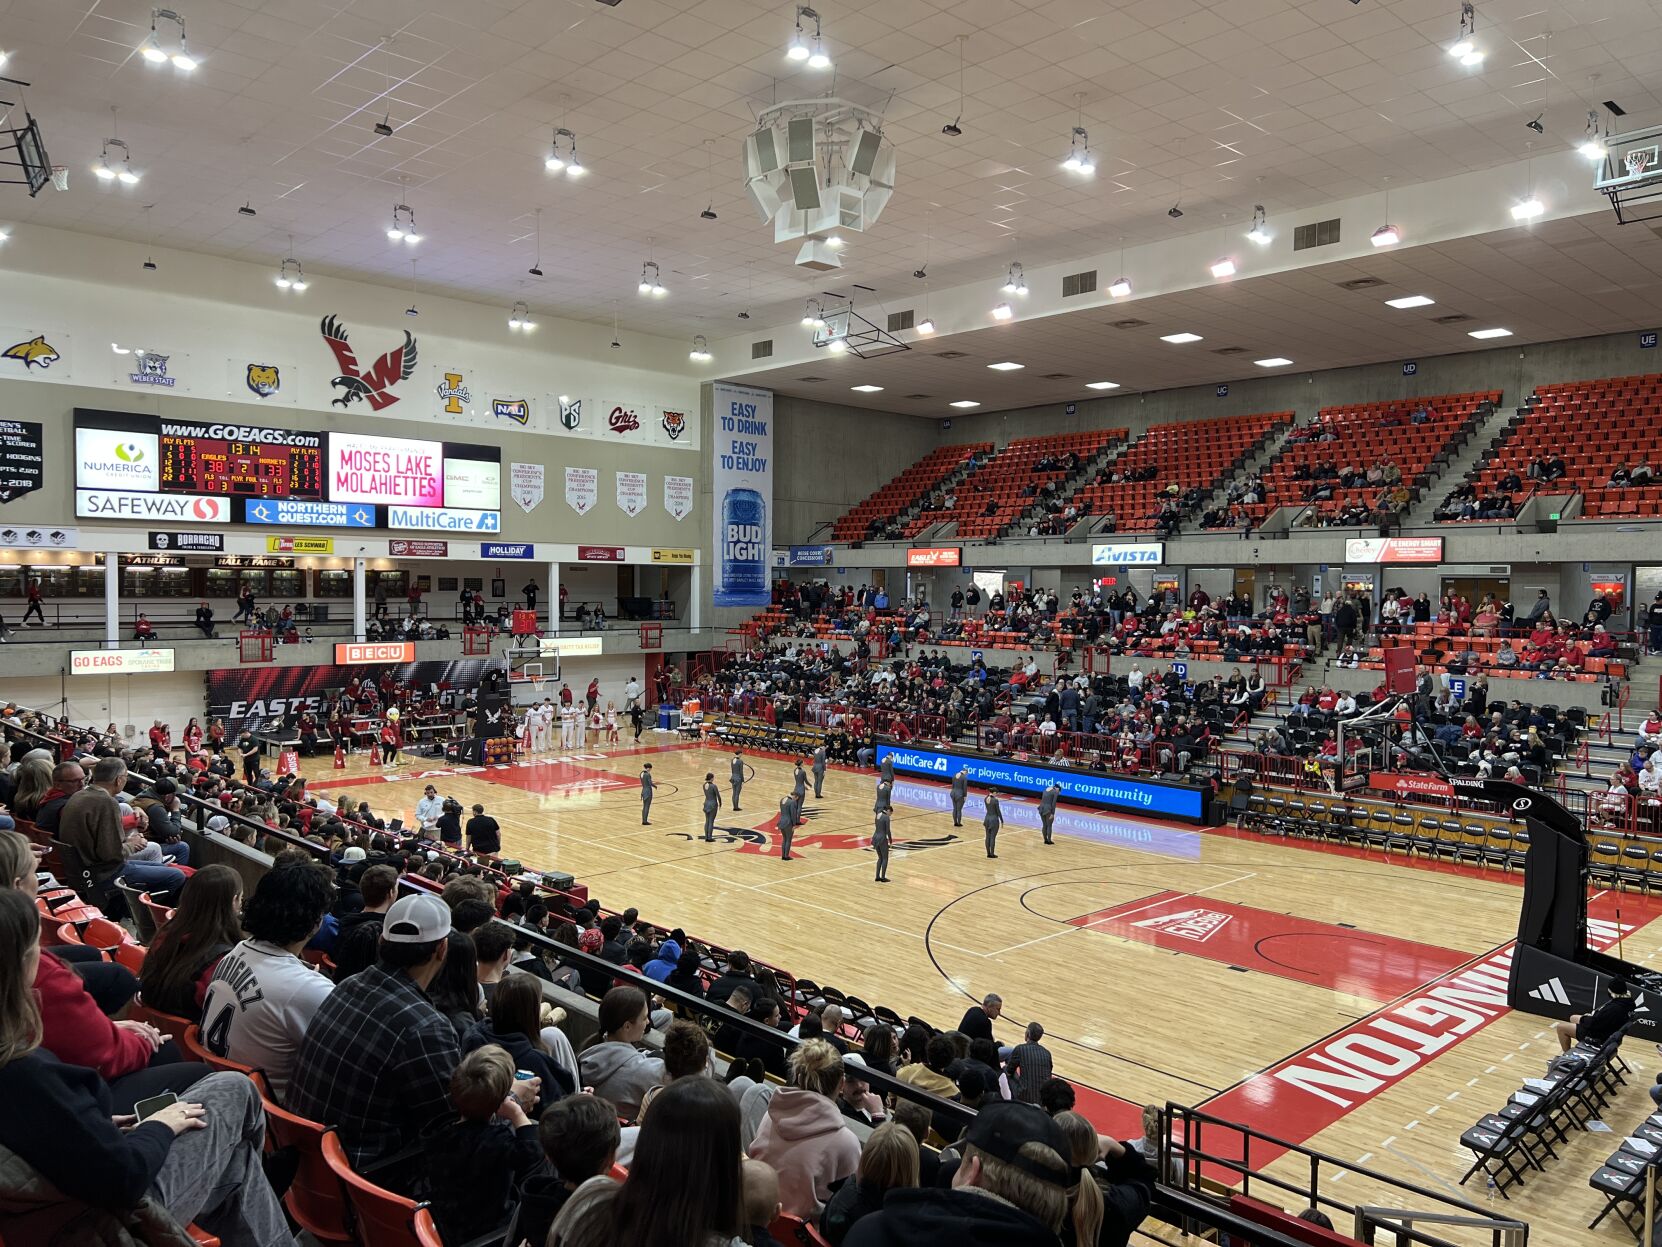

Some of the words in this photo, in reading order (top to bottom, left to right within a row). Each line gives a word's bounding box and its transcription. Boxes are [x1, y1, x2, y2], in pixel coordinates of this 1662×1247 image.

[1641, 334, 1656, 345] UE
[1403, 364, 1416, 373] UD
[132, 374, 154, 382] WEBER
[155, 377, 174, 386] STATE
[437, 382, 470, 402] Vandals
[497, 404, 524, 415] NAU
[731, 402, 757, 419] EASY
[608, 406, 640, 431] Griz
[721, 416, 735, 432] TO
[737, 418, 767, 436] DRINK
[161, 424, 320, 448] www.GOEAGS.com
[231, 443, 260, 455] 13:14
[731, 440, 757, 457] EASY
[6, 453, 41, 462] HODGINS
[200, 453, 227, 462] EAGLES
[258, 458, 287, 466] HORNETS
[340, 449, 391, 474] MOSES
[396, 453, 433, 477] LAKE
[721, 455, 734, 470] TO
[736, 456, 767, 472] ENJOY
[83, 461, 152, 474] NUMERICA
[208, 460, 223, 473] 38
[241, 464, 248, 474] 2
[268, 464, 282, 476] 33
[336, 471, 436, 498] MOLAHIETTES
[87, 495, 189, 516] SAFEWAY
[277, 502, 347, 514] NORTHERN
[277, 513, 347, 525] QUEST.COM
[391, 510, 473, 530] MultiCare
[727, 524, 762, 542] BUD
[177, 533, 220, 547] BORRACHO
[489, 546, 525, 555] HOLLIDAY
[723, 542, 765, 561] LIGHT
[132, 556, 180, 565] ATHLETIC
[218, 558, 242, 566] HALL
[351, 647, 400, 659] BECU
[73, 656, 90, 668] GO
[93, 655, 123, 667] EAGS
[892, 752, 933, 768] MultiCare
[963, 764, 976, 775] For
[978, 767, 1012, 782] players,
[1013, 772, 1034, 784] fans
[1035, 776, 1054, 788] and
[1074, 782, 1153, 805] community
[1448, 778, 1485, 788] SPALDING
